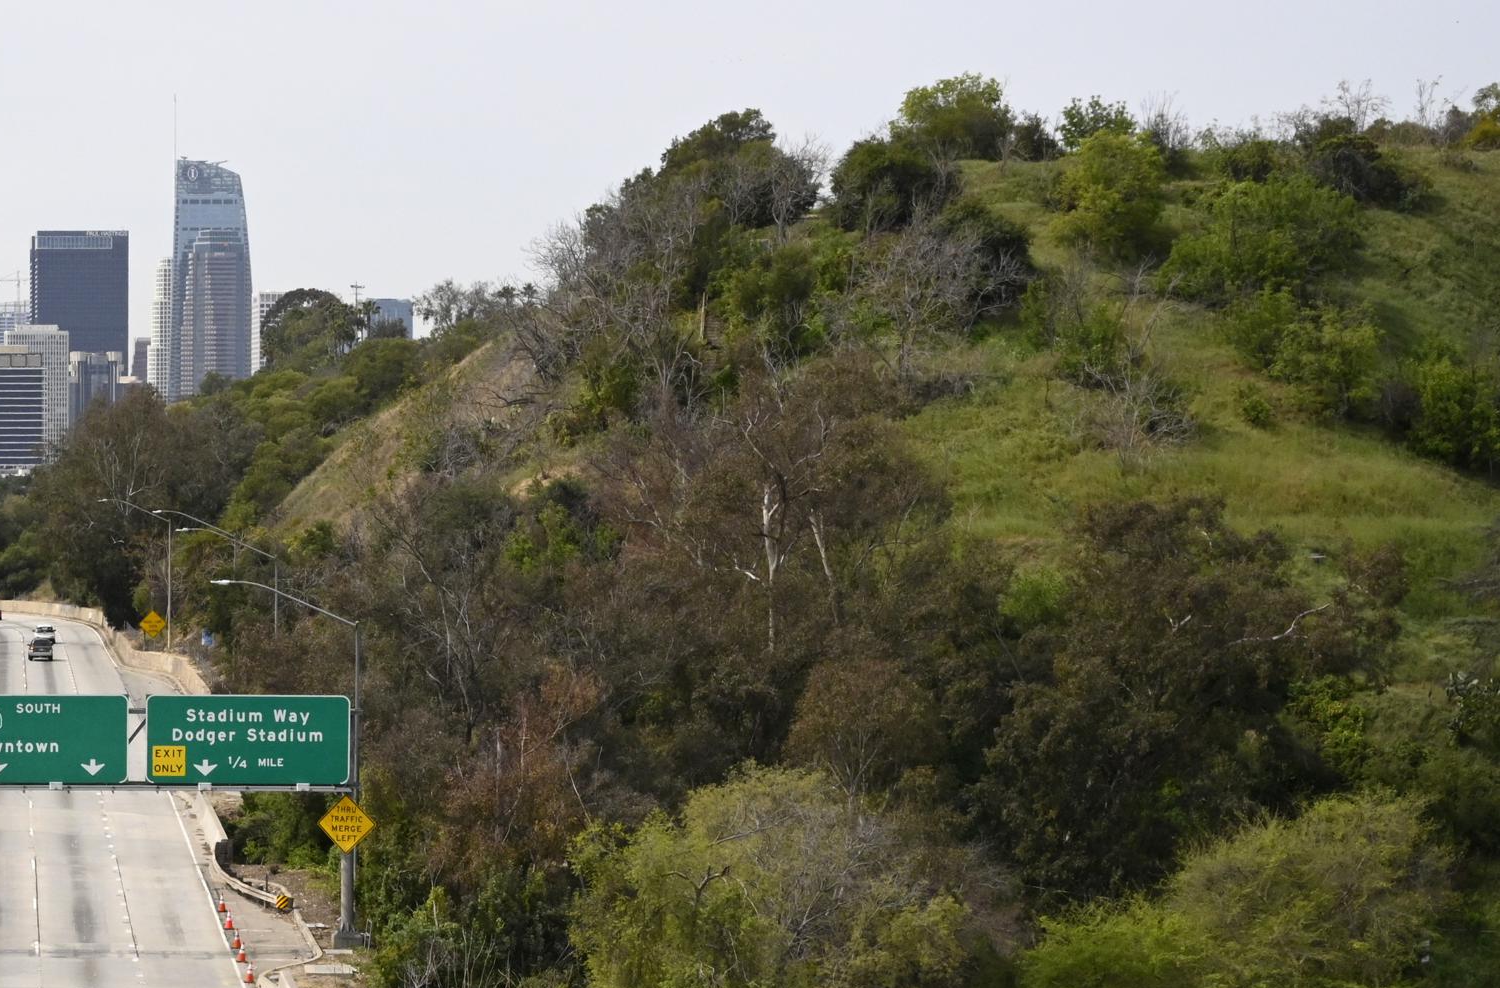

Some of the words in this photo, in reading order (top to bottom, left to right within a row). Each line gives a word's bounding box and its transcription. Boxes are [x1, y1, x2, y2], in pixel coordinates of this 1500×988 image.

[16, 703, 61, 714] SOUTH
[186, 708, 263, 723] Stadium
[274, 709, 310, 726] Way
[172, 728, 236, 745] Dodger
[247, 728, 323, 742] Stadium
[155, 749, 183, 758] EXIT
[258, 758, 284, 767] MILE
[154, 764, 183, 773] ONLY
[336, 806, 357, 814] THRU
[331, 815, 363, 823] TRAFFIC
[331, 825, 362, 833] MERGE
